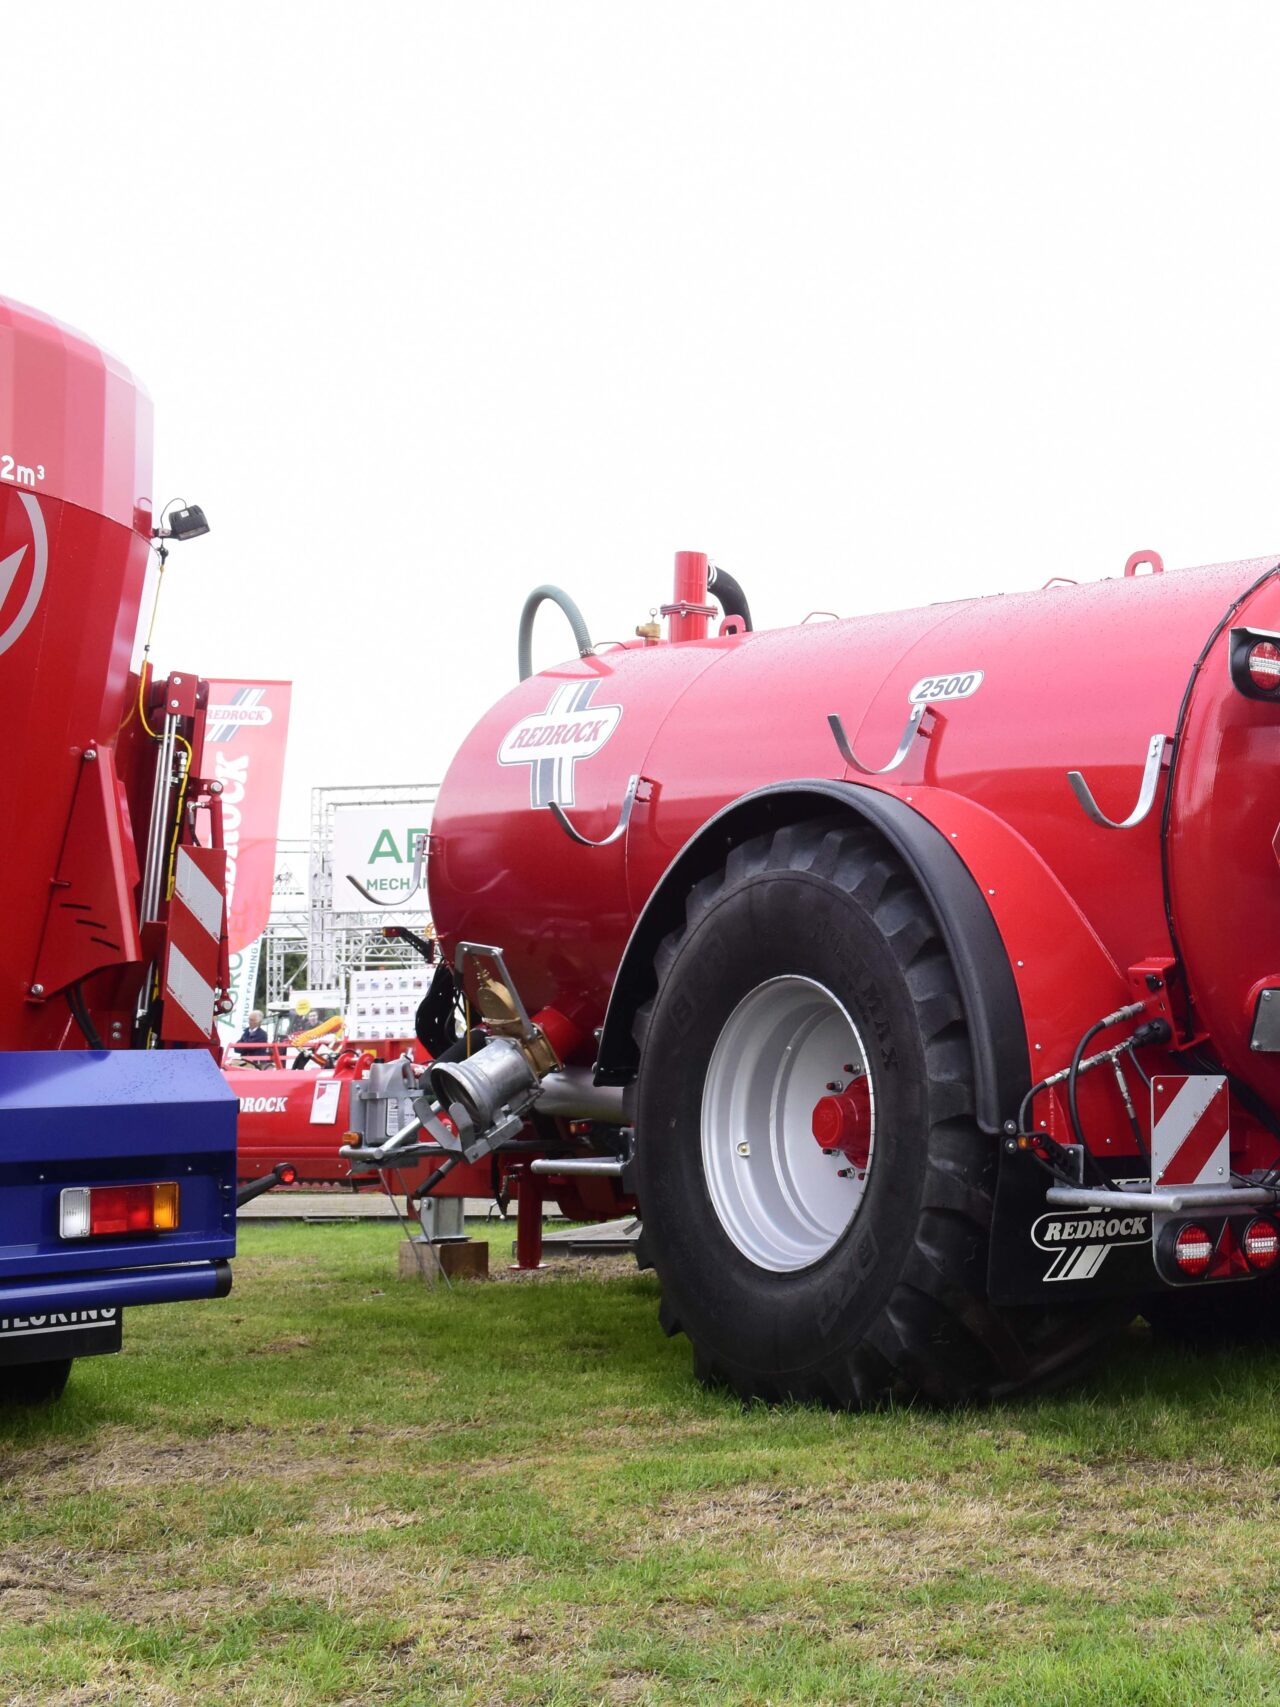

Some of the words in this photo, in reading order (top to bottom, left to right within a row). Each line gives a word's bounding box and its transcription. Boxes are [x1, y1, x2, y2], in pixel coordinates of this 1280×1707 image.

[915, 675, 975, 699] 2500
[509, 719, 609, 750] REDROCK
[366, 877, 428, 890] MECH
[1043, 1217, 1148, 1241] REDROCK
